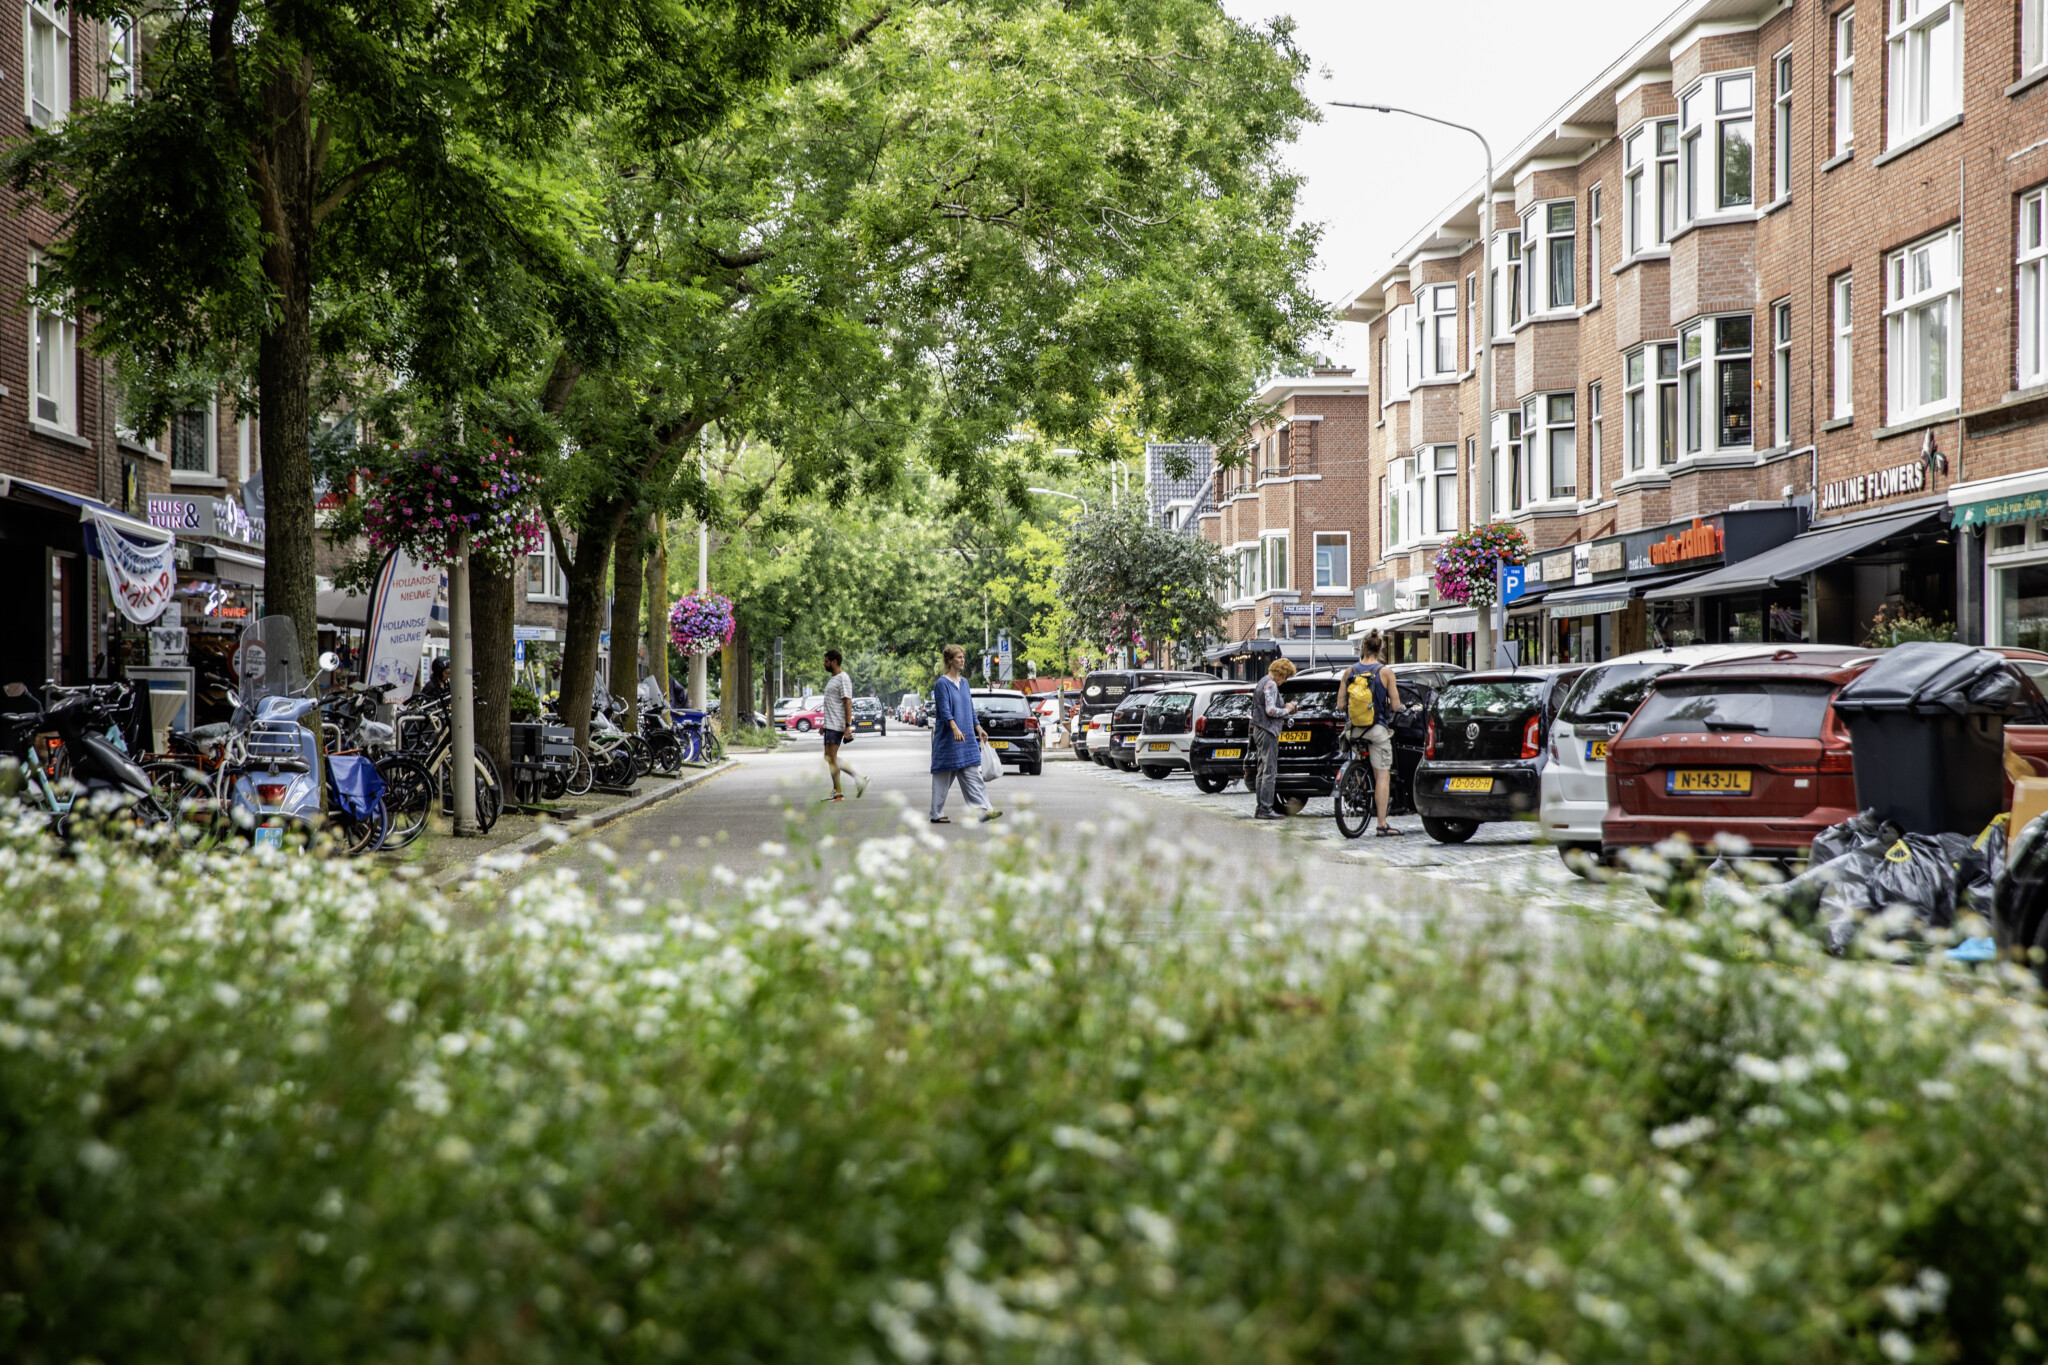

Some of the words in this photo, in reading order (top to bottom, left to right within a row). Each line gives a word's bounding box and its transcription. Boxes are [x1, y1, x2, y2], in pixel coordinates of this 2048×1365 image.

[1822, 476, 1865, 509] JAILINE
[1867, 461, 1924, 499] FLOWERS
[149, 501, 182, 514] HUIS
[184, 502, 200, 528] &
[149, 515, 182, 528] TUIN
[393, 574, 436, 588] HOLLANDSE
[1507, 576, 1519, 594] P
[401, 589, 431, 601] NIEUWE
[383, 618, 426, 631] HOLLANDSE
[390, 632, 421, 645] NIEUWE
[1450, 777, 1490, 789] KD-060-H
[1681, 773, 1741, 787] N-143-JL
